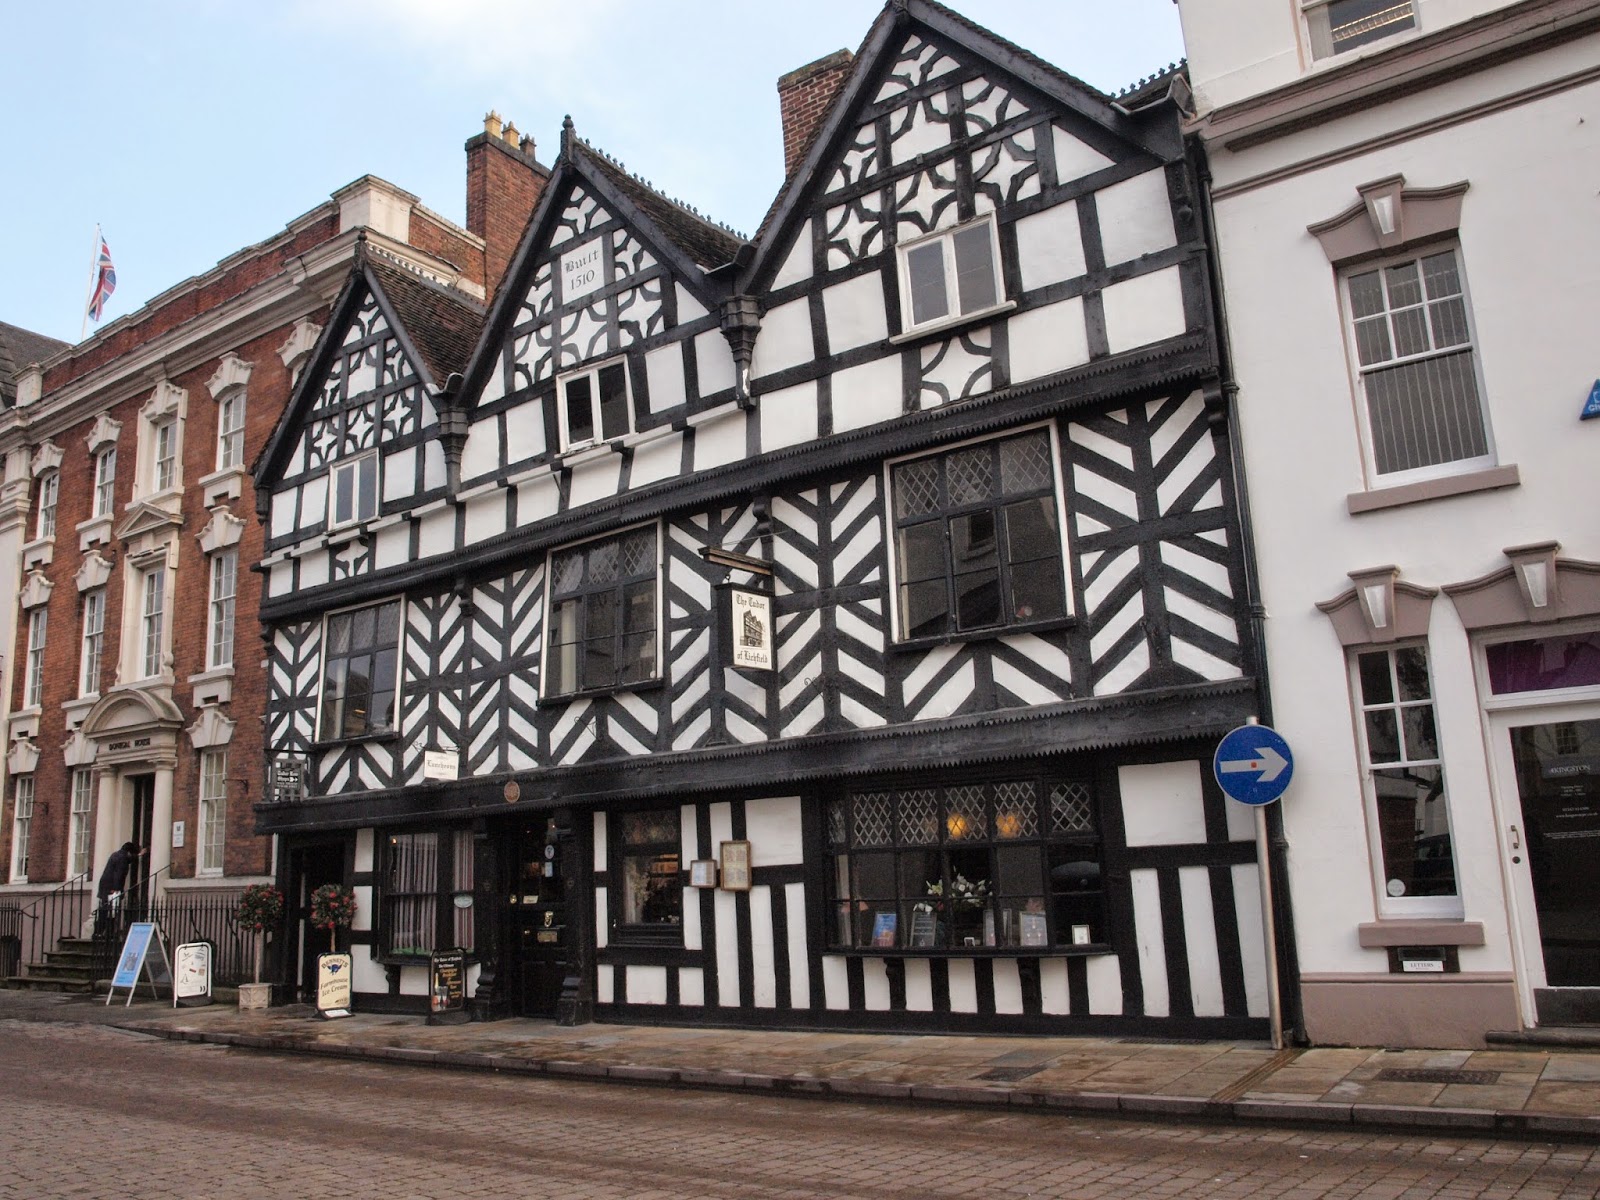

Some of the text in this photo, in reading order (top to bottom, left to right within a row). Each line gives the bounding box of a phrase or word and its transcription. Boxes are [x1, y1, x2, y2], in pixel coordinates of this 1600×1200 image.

[564, 249, 599, 273] Built
[570, 269, 595, 290] 1510
[735, 593, 766, 610] The Tudor
[736, 650, 768, 665] of Lichfield
[321, 957, 349, 969] BENNETTS
[320, 977, 348, 990] Farmhouse
[321, 984, 348, 997] Ice Cream
